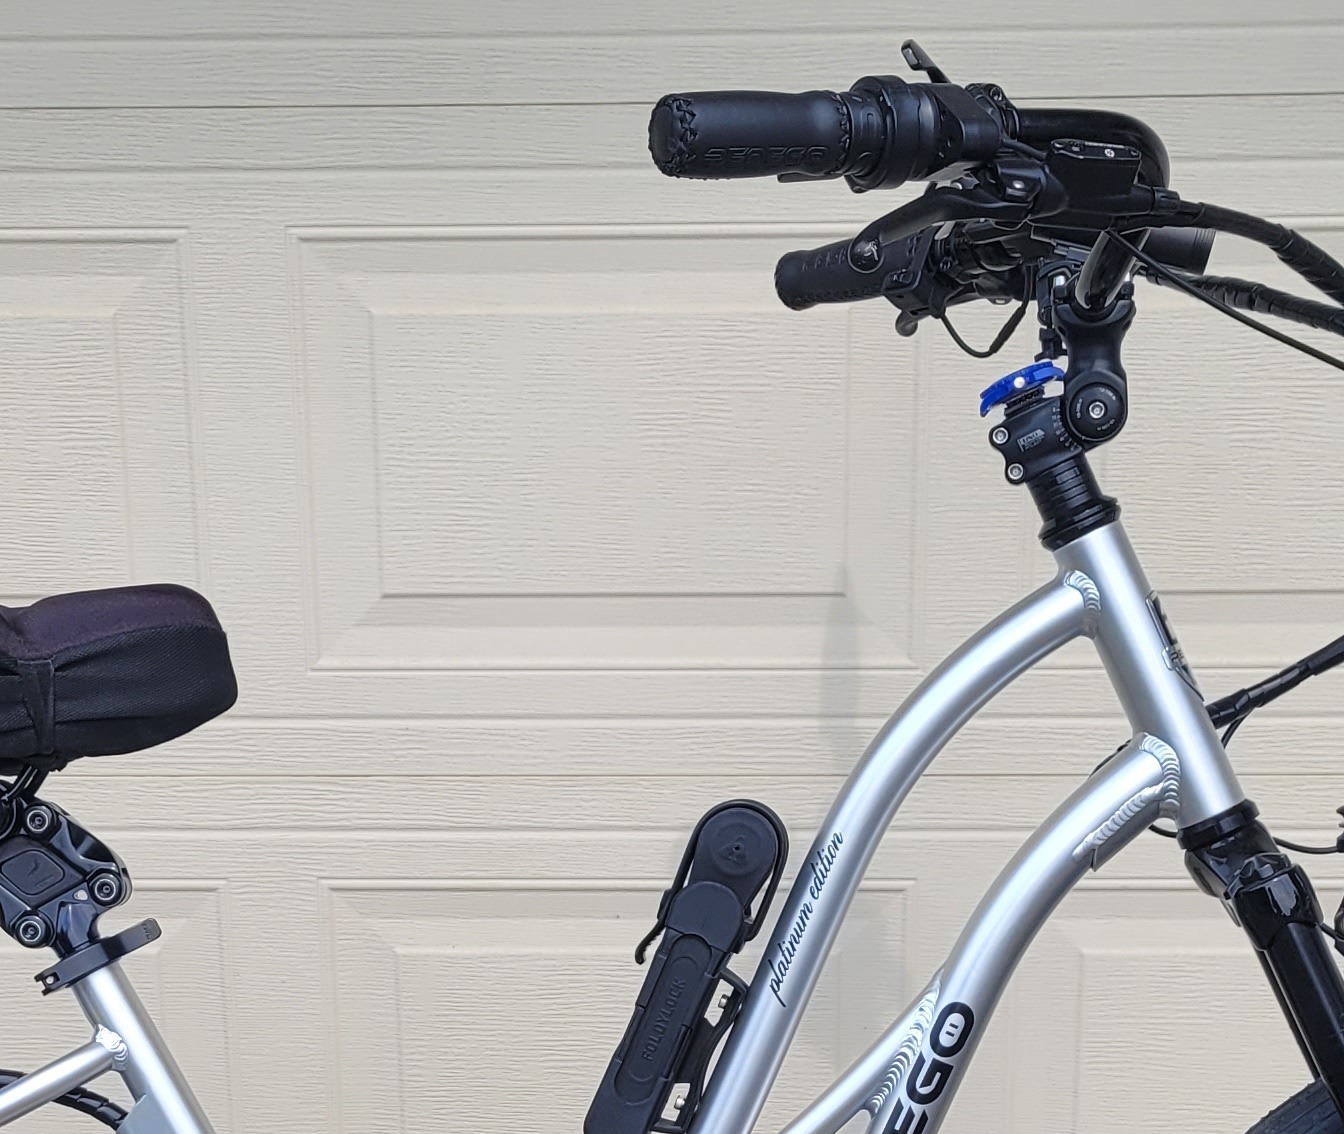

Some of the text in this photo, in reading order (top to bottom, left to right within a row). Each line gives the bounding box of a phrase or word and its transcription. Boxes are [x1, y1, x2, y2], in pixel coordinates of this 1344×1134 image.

[766, 831, 844, 1008] platinum edition
[641, 976, 686, 1063] FOLDYLOCK
